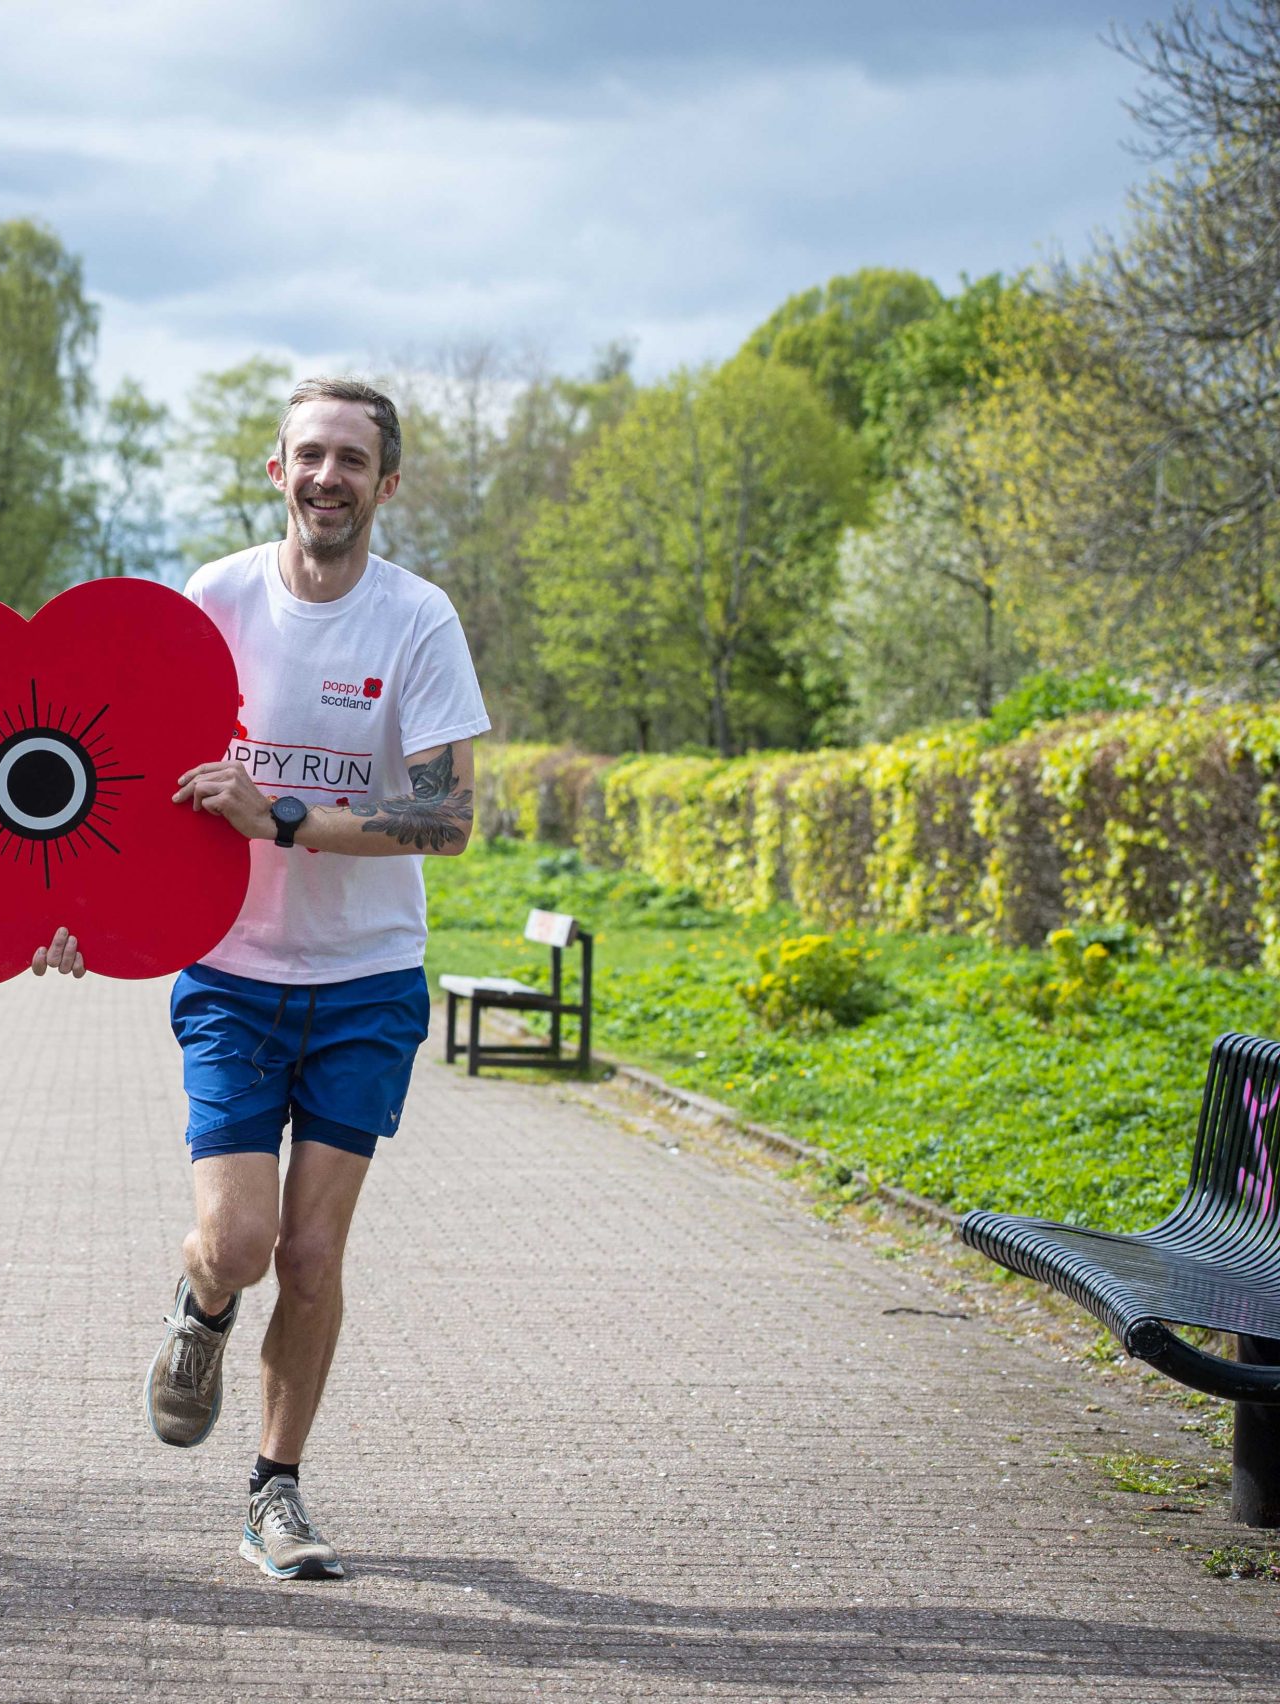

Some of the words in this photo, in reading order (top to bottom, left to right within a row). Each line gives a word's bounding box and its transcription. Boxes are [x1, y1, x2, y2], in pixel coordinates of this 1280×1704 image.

[322, 680, 361, 696] poppy
[321, 694, 371, 711] scotland
[227, 746, 293, 779] PPY
[302, 754, 372, 786] RUN
